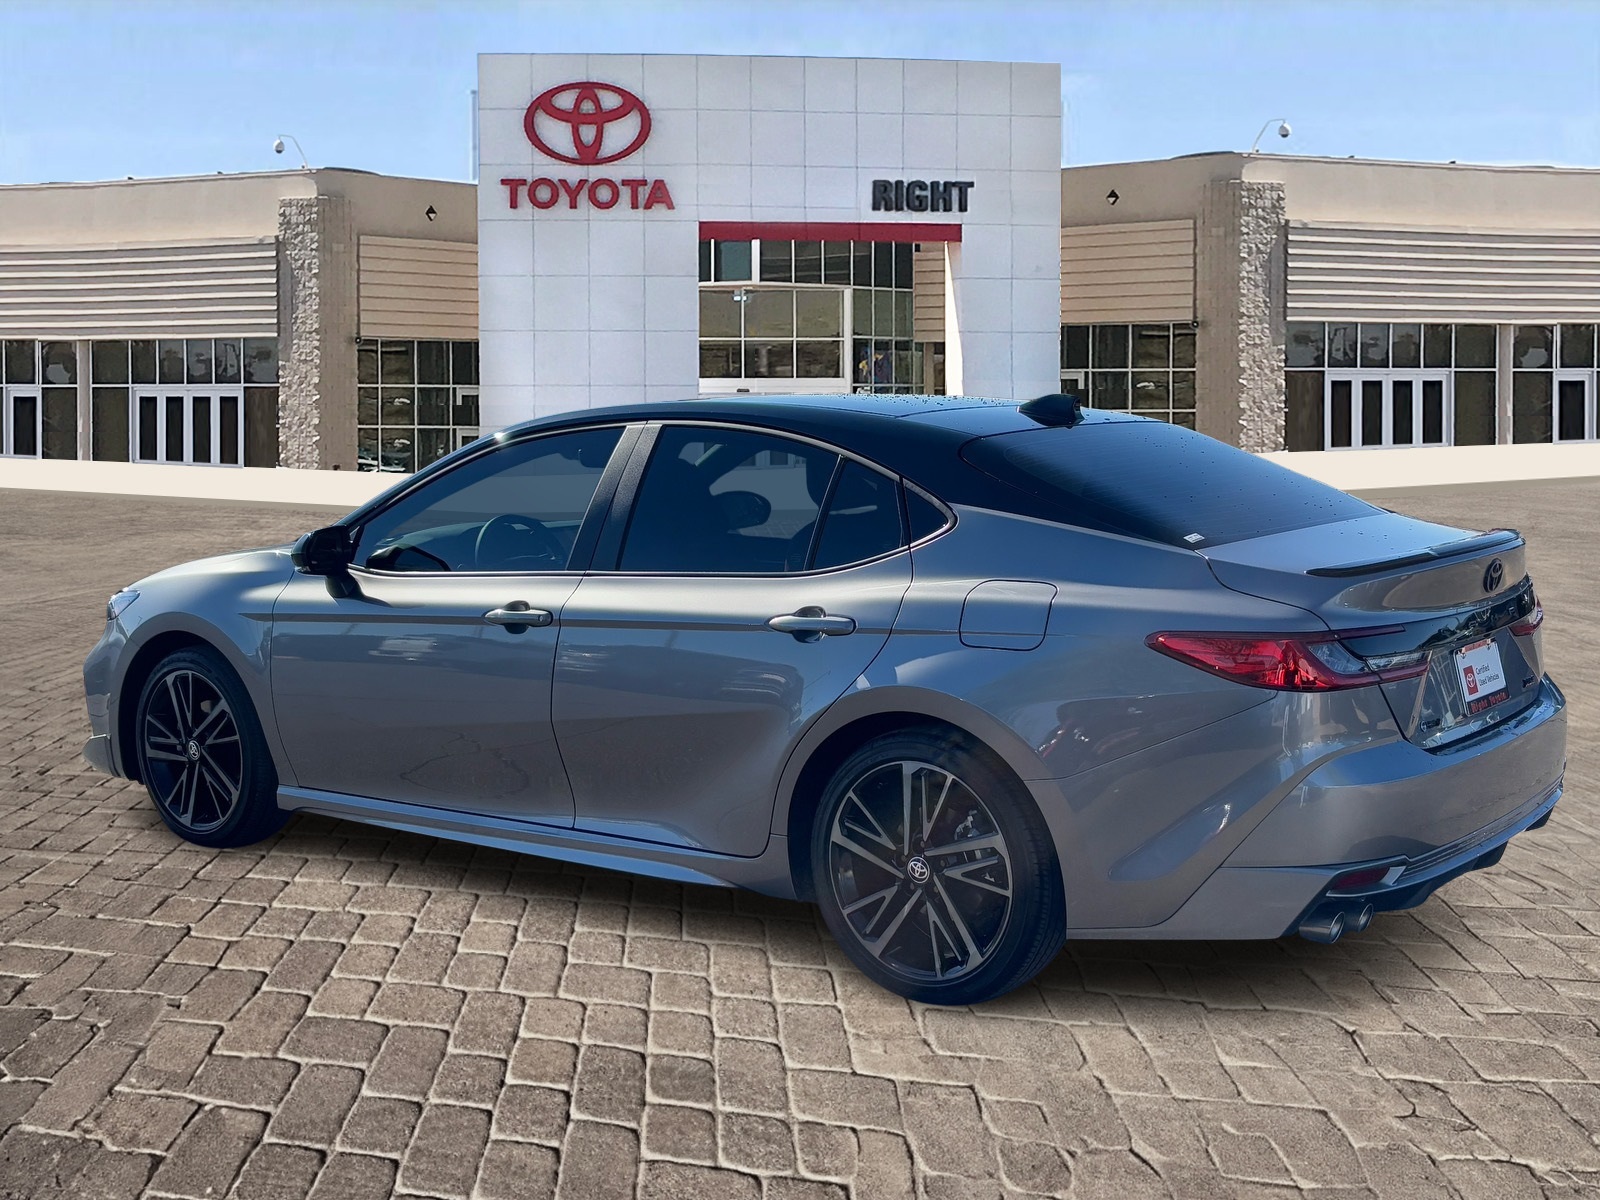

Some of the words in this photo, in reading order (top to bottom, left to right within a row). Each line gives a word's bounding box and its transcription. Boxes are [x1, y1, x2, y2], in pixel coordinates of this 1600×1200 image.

[500, 178, 676, 210] TOYOTA
[871, 179, 975, 212] RIGHT
[1475, 663, 1490, 675] Certified
[1479, 677, 1488, 687] Used
[1487, 672, 1500, 682] Vehicles
